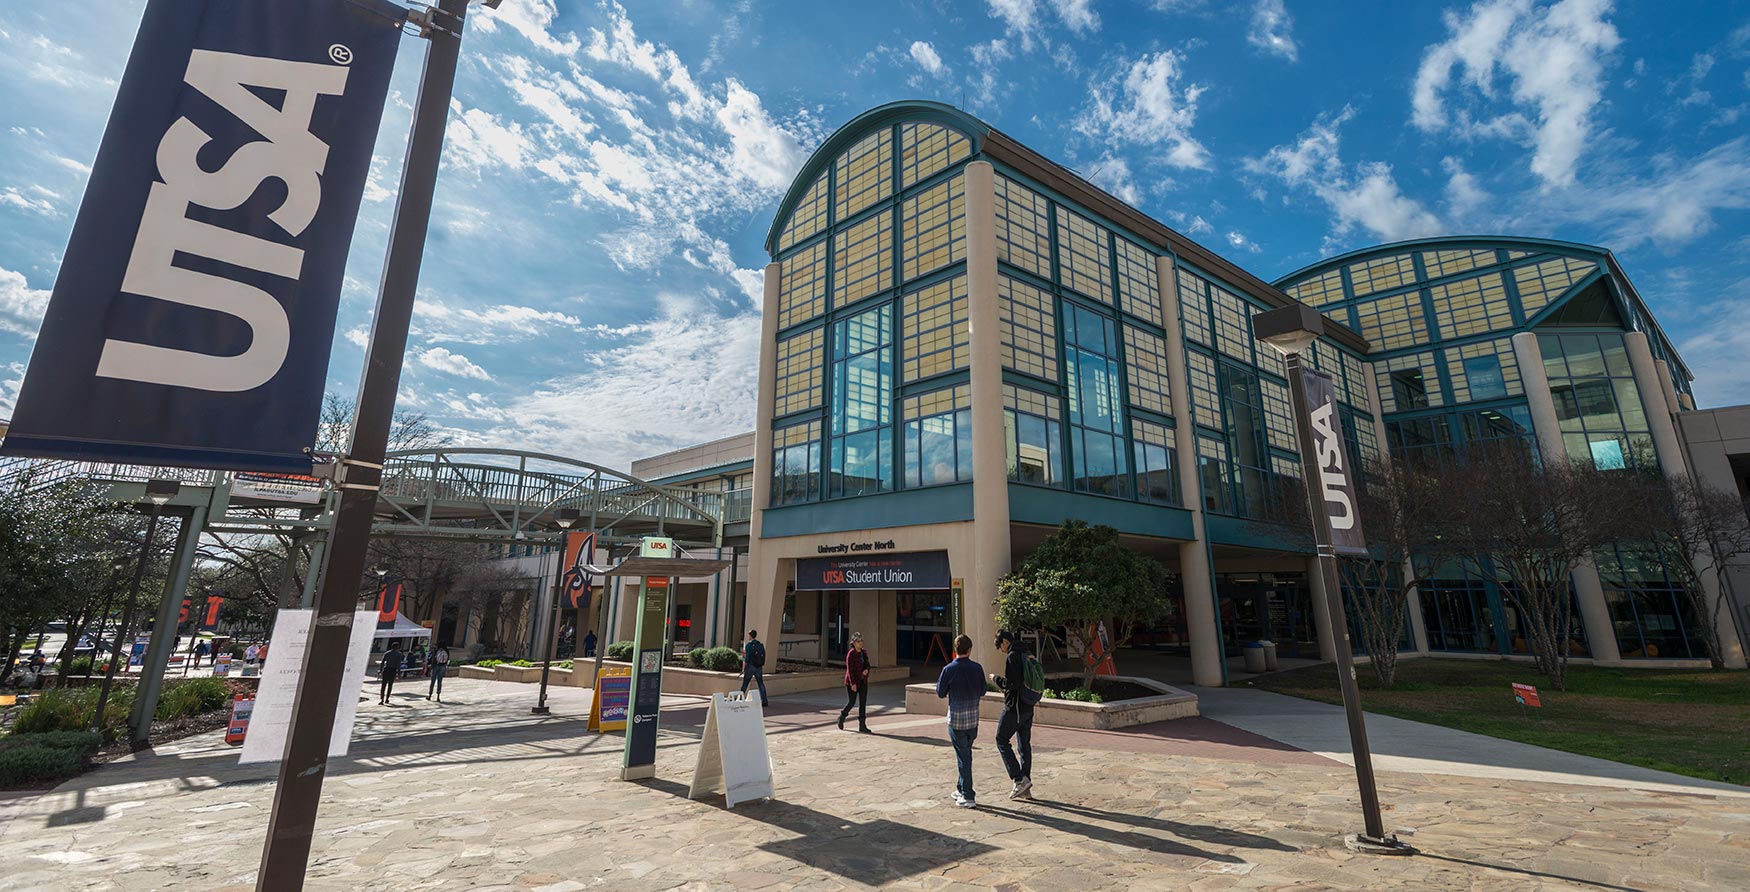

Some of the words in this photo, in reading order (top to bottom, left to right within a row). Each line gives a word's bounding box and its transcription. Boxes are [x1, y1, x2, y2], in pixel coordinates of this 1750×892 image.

[1311, 402, 1354, 529] UTSA
[650, 542, 667, 550] UTSA
[817, 544, 849, 554] University
[850, 542, 873, 552] Center
[874, 540, 895, 550] North
[823, 570, 845, 584] UTSA
[846, 570, 882, 584] Student
[884, 569, 913, 583] Union
[205, 595, 225, 626] T
